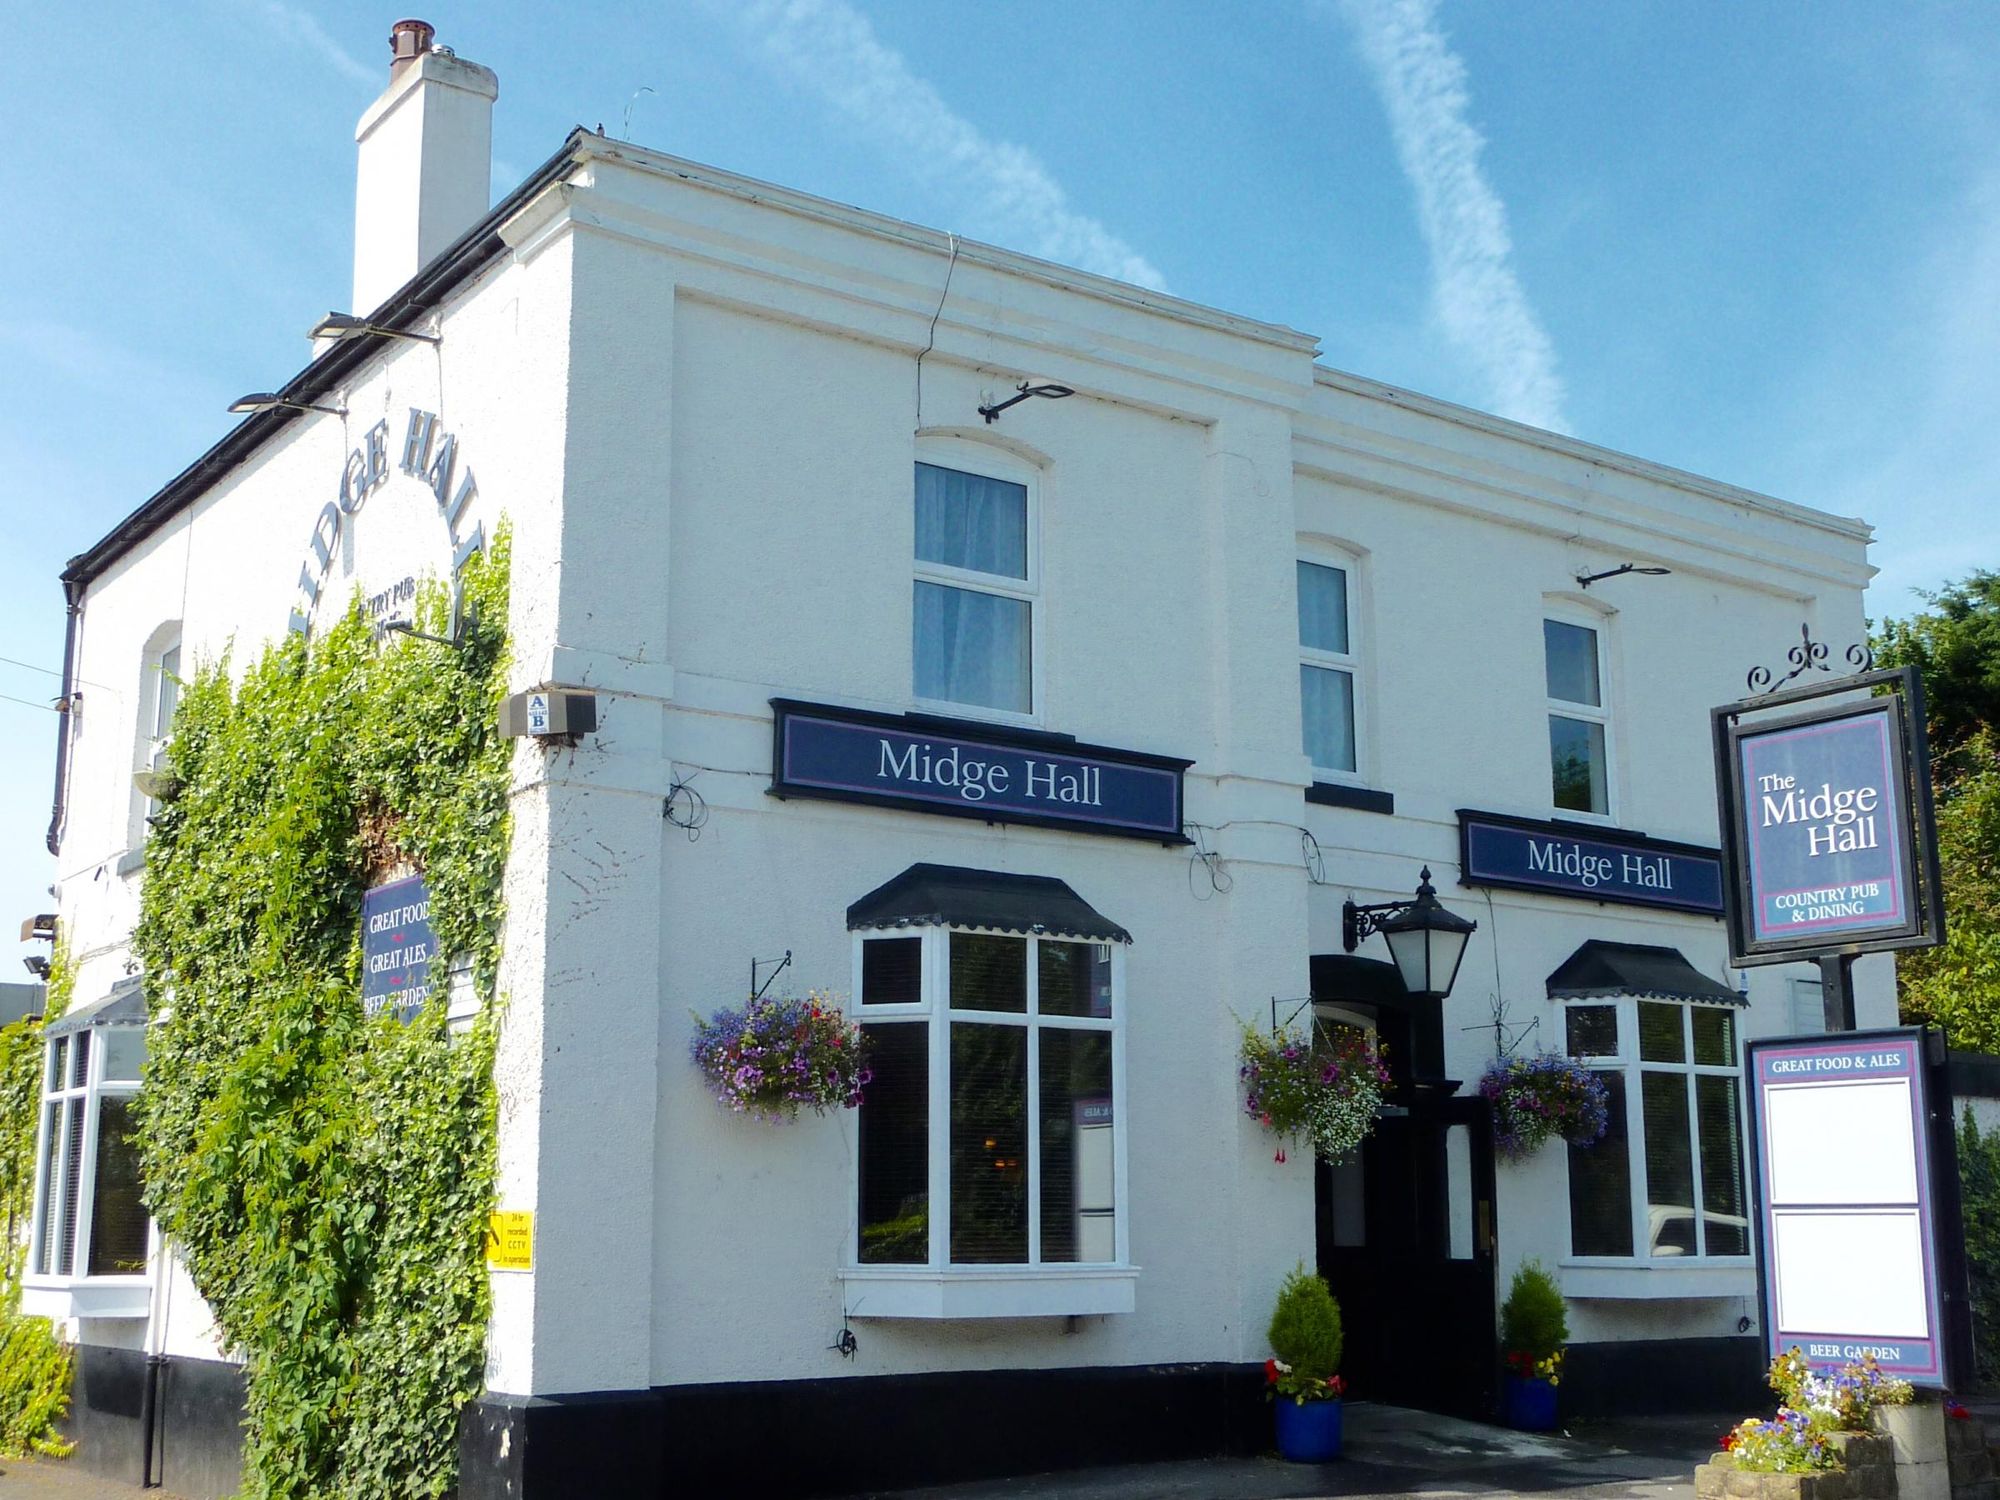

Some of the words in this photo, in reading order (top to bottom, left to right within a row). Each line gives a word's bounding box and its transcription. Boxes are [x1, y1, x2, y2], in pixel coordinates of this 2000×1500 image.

[399, 407, 485, 582] HALL
[393, 576, 415, 607] PUB
[531, 695, 544, 707] A
[533, 715, 545, 727] B
[877, 739, 1009, 801] Midge
[1024, 759, 1102, 807] Hall
[1758, 773, 1795, 794] The
[1761, 783, 1878, 828] Midge
[1807, 816, 1879, 858] Hall
[1527, 839, 1613, 888] Midge
[1621, 854, 1673, 890] Hall
[1775, 886, 1847, 909] COUNTRY
[1850, 883, 1880, 900] PUB
[370, 908, 401, 934] GREAT
[401, 900, 430, 925] FOOD
[1792, 908, 1805, 923] &
[1808, 900, 1864, 921] DINING
[370, 949, 402, 974] GREAT
[402, 943, 426, 967] ALES
[1772, 1058, 1814, 1073] GREAT
[1815, 1056, 1851, 1070] FOOD
[1854, 1055, 1866, 1069] &
[1869, 1053, 1901, 1068] ALES
[507, 1240, 527, 1250] CCTV
[1810, 1343, 1841, 1357] BEER
